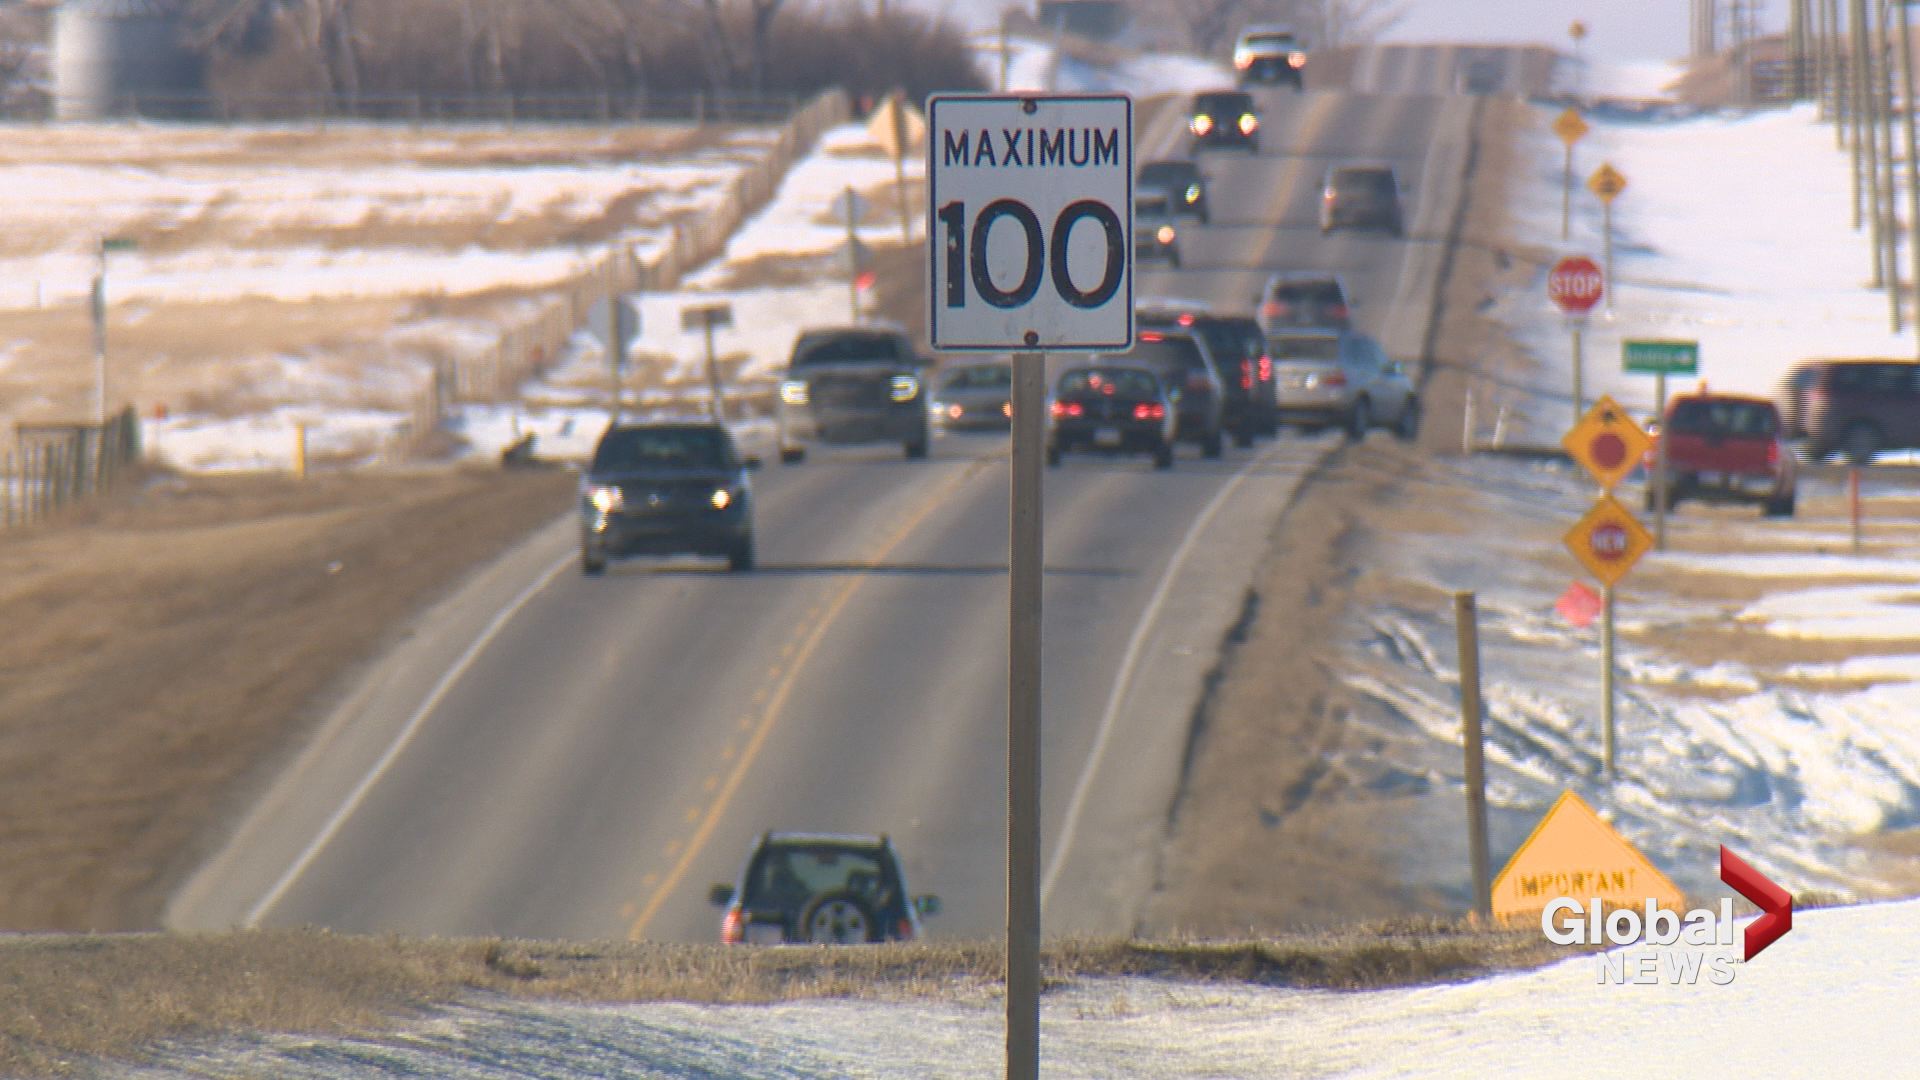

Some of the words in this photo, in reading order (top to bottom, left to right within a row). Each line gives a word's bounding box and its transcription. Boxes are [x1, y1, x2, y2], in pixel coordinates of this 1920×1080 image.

[944, 128, 1118, 167] MAXIMUM
[938, 198, 1125, 310] 100
[1550, 271, 1601, 297] STOP
[1513, 868, 1637, 898] IMPORTANT
